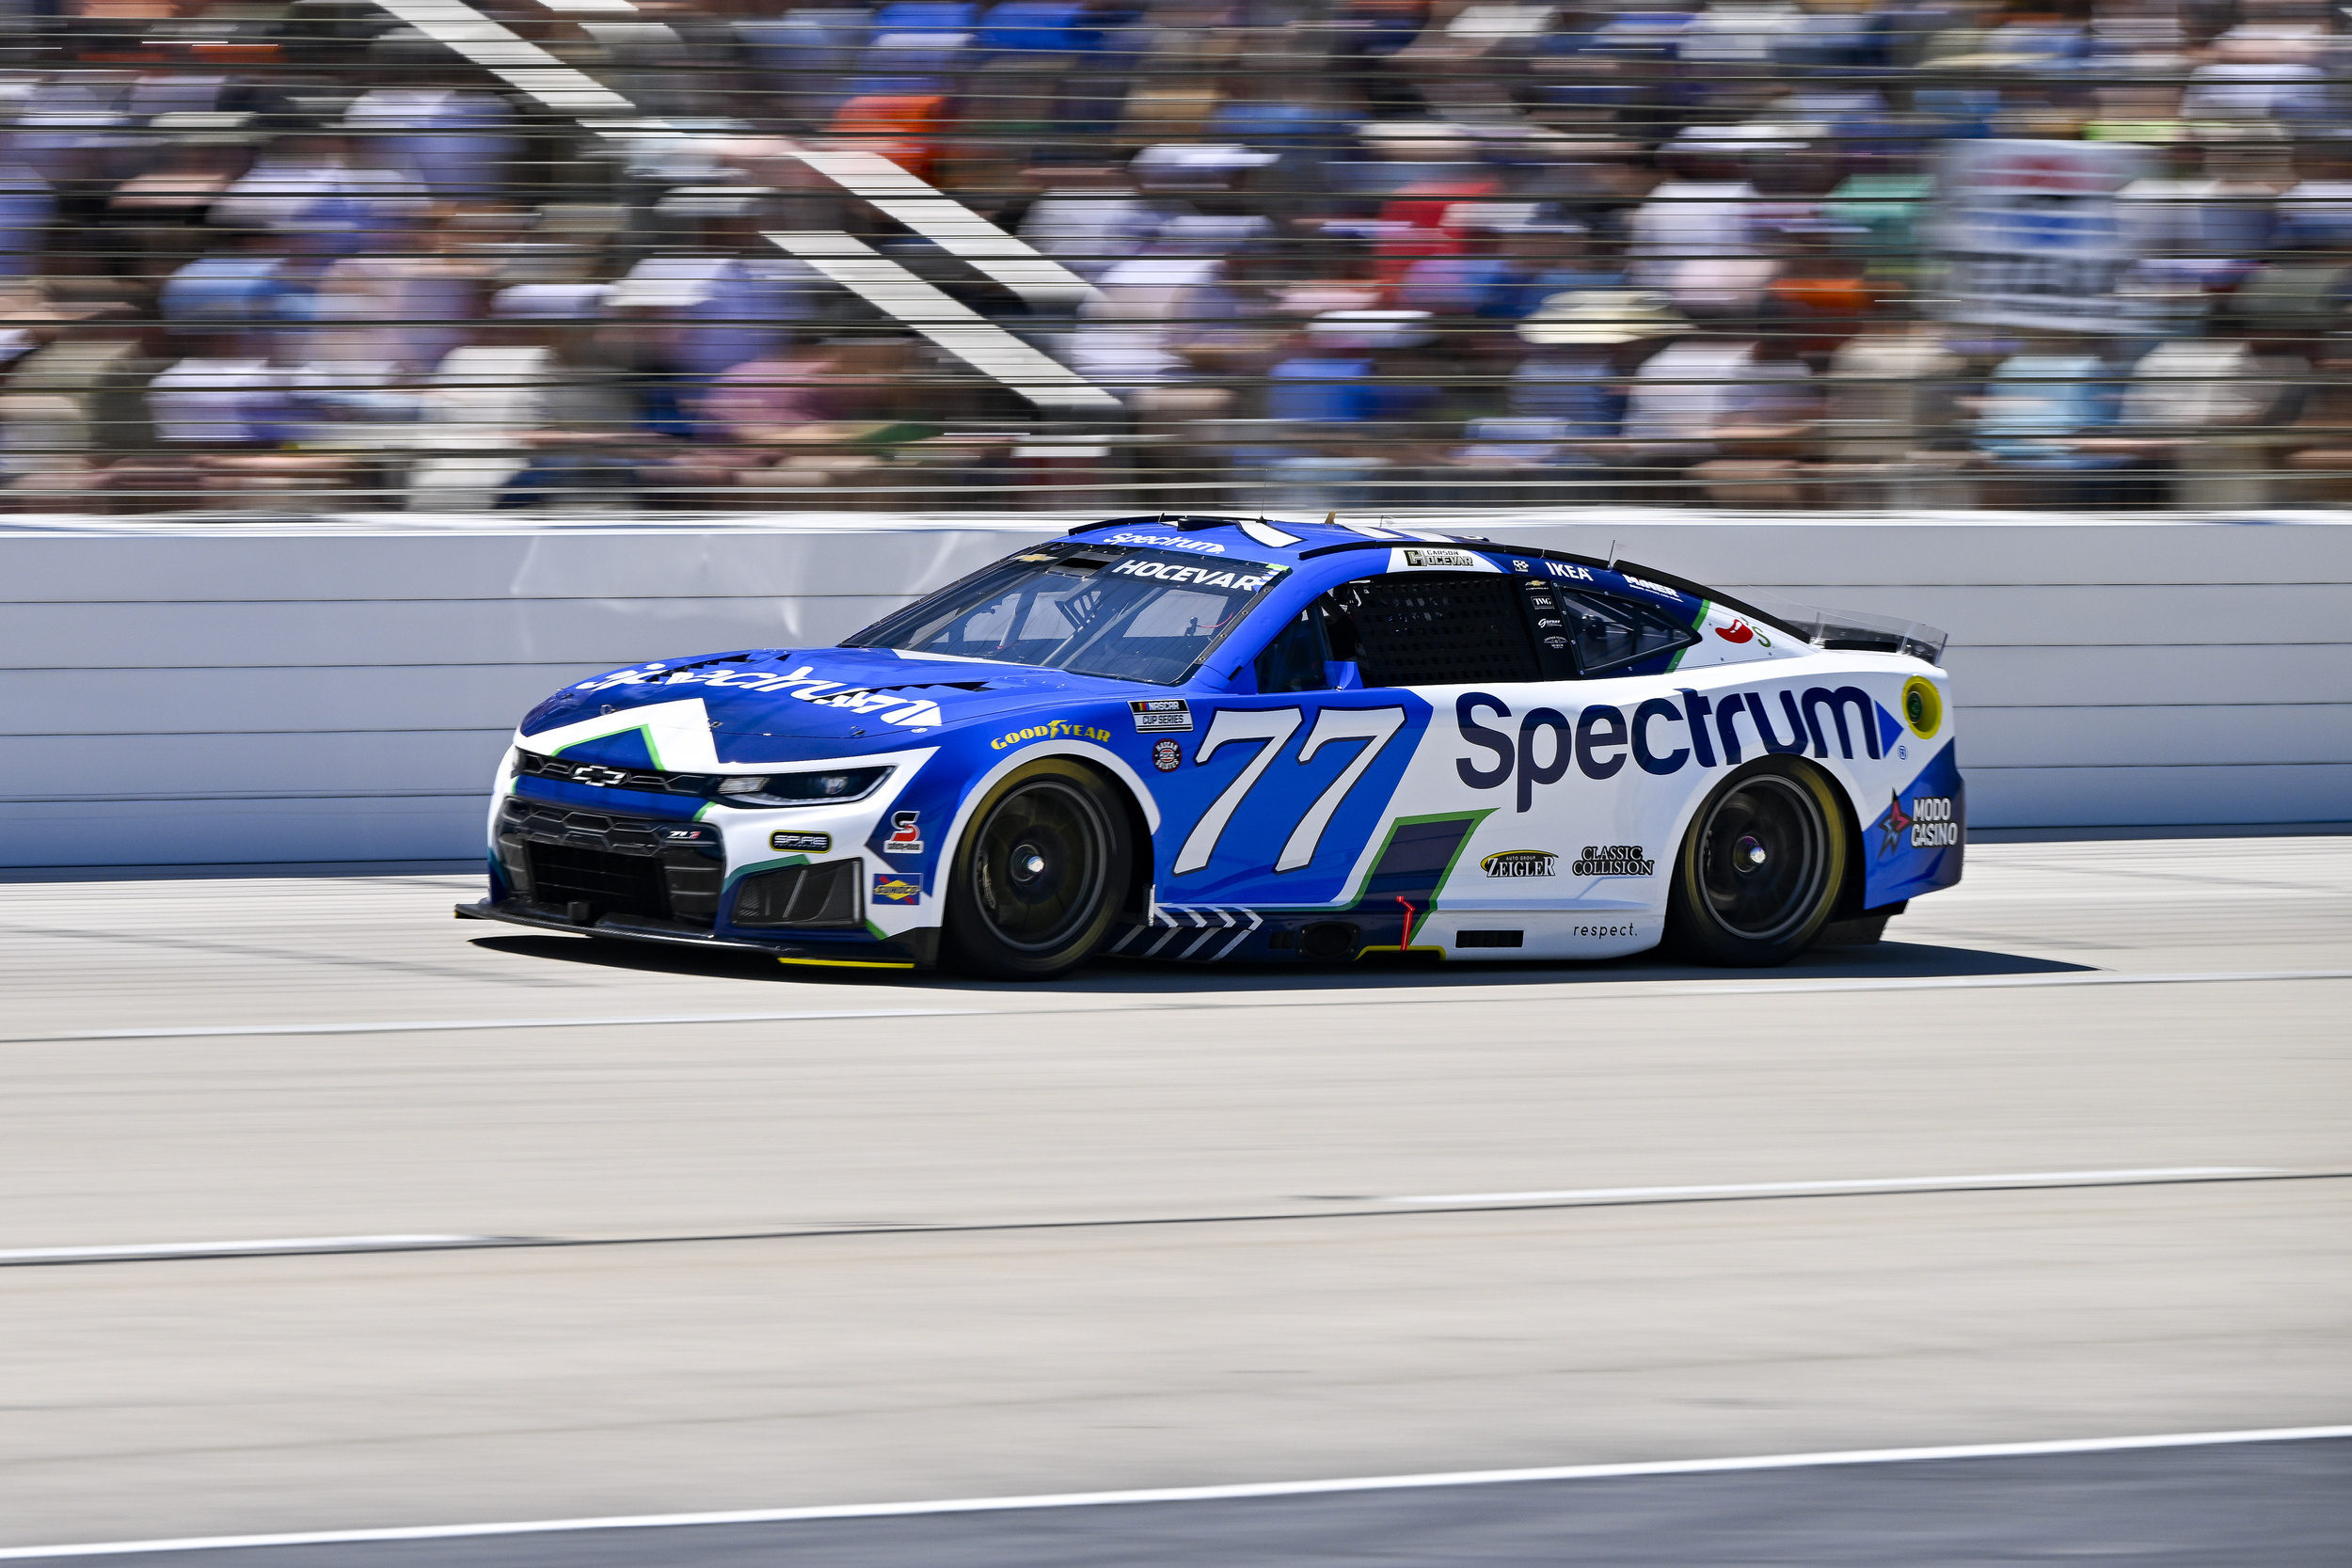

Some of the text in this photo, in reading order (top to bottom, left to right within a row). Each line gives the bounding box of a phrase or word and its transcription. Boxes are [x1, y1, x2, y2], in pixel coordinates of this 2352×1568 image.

[1104, 532, 1220, 554] Spectrum
[1406, 550, 1473, 566] HOCEVAR
[1112, 560, 1262, 591] HOCEVAR
[1545, 562, 1594, 581] IKEA
[1148, 702, 1180, 711] NASCAR
[1143, 715, 1184, 724] CUP SERIES
[1455, 686, 1882, 813] Spectrum
[1171, 704, 1408, 877] 77
[1913, 798, 1951, 821] MODO
[1911, 822, 1958, 847] CASINO
[1581, 847, 1643, 861] CLASSIC
[1486, 857, 1555, 878] ZEIGLER
[1572, 860, 1654, 876] COLLISION
[875, 886, 920, 895] SUNOCO
[1573, 923, 1638, 939] respect.
